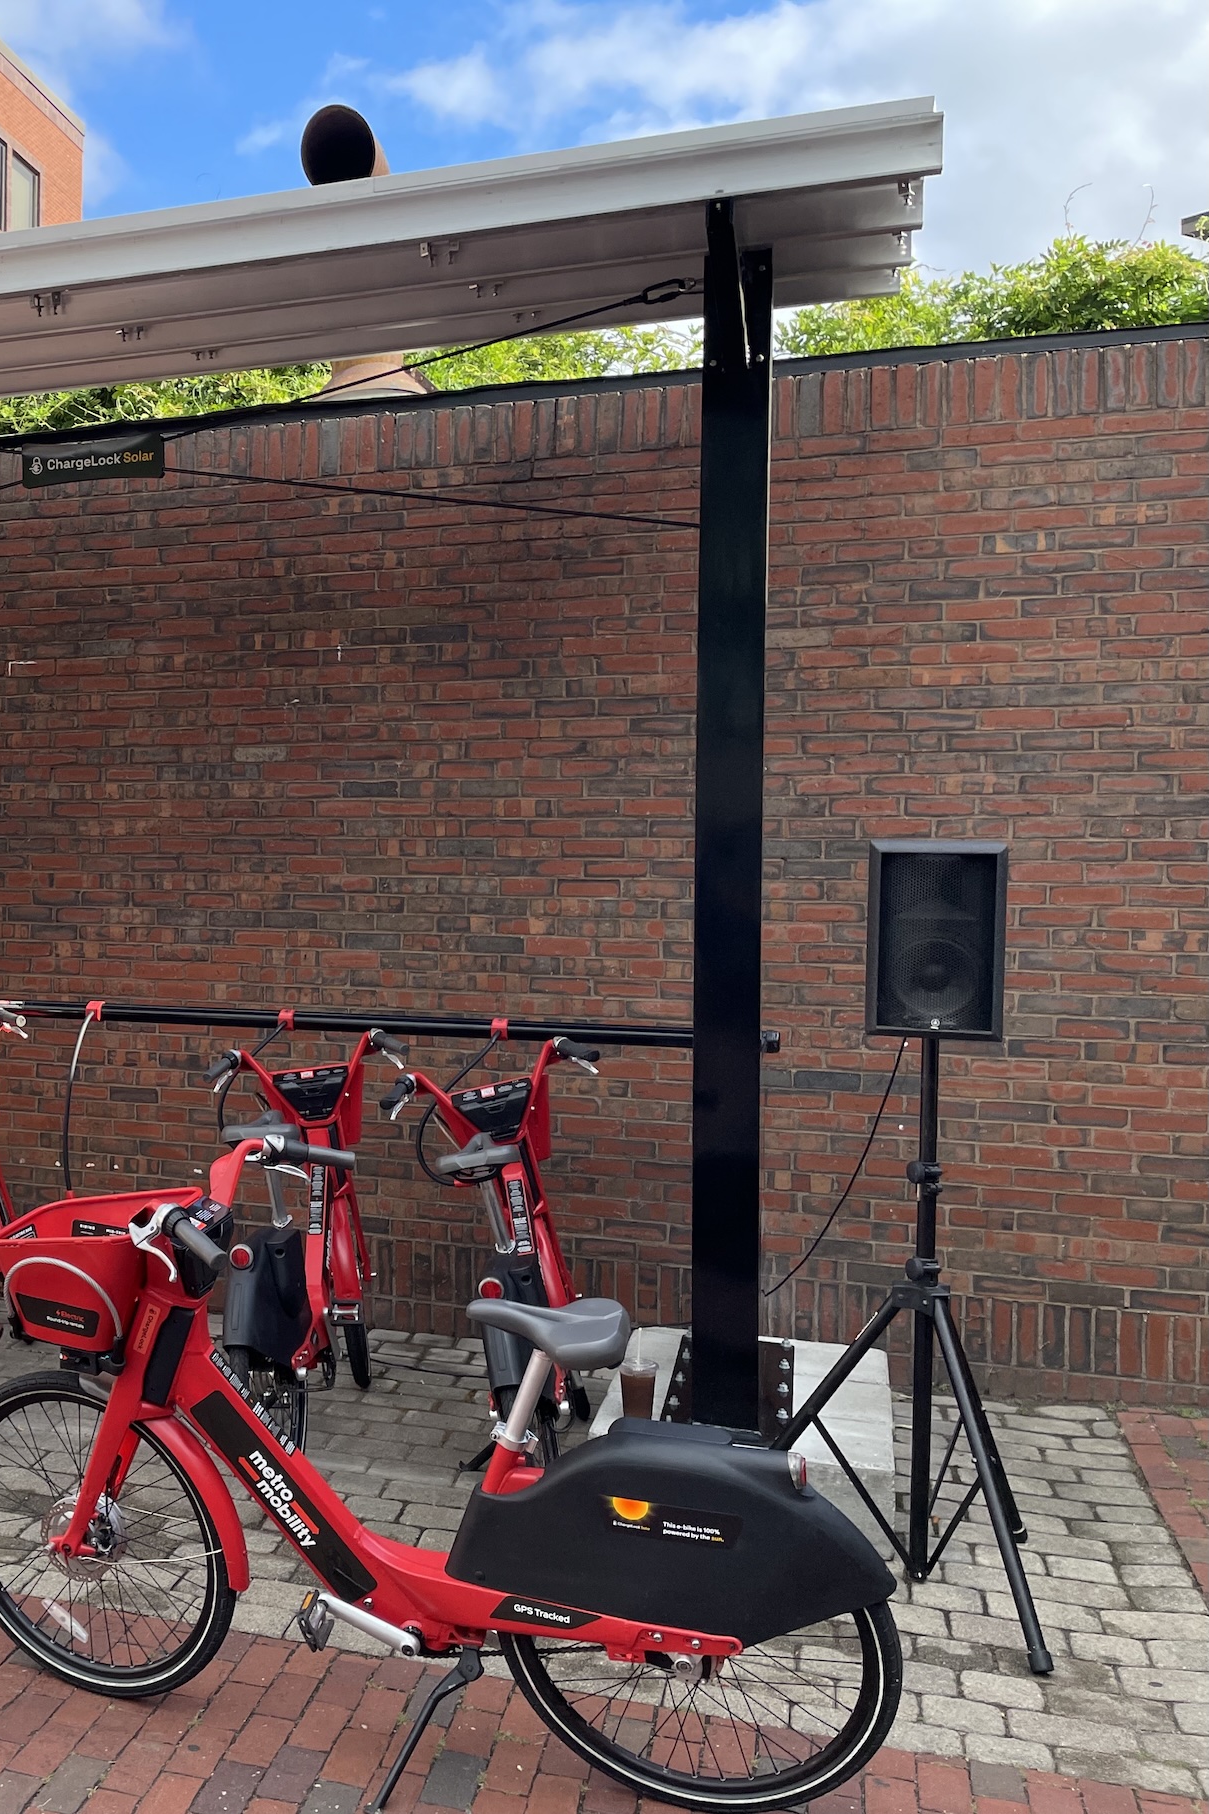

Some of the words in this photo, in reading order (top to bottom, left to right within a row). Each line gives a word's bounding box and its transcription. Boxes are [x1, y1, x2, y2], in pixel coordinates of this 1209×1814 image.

[47, 453, 121, 470] ChargeLock
[123, 450, 154, 463] Solar
[249, 1450, 293, 1502] metro
[256, 1480, 316, 1547] mobility
[662, 1521, 676, 1529] This
[676, 1523, 696, 1532] e-bike
[703, 1527, 720, 1535] 100%
[662, 1528, 690, 1538] powered
[690, 1532, 699, 1540] by
[699, 1533, 710, 1541] the
[513, 1603, 534, 1616] GPS
[534, 1608, 570, 1624] Tracked
